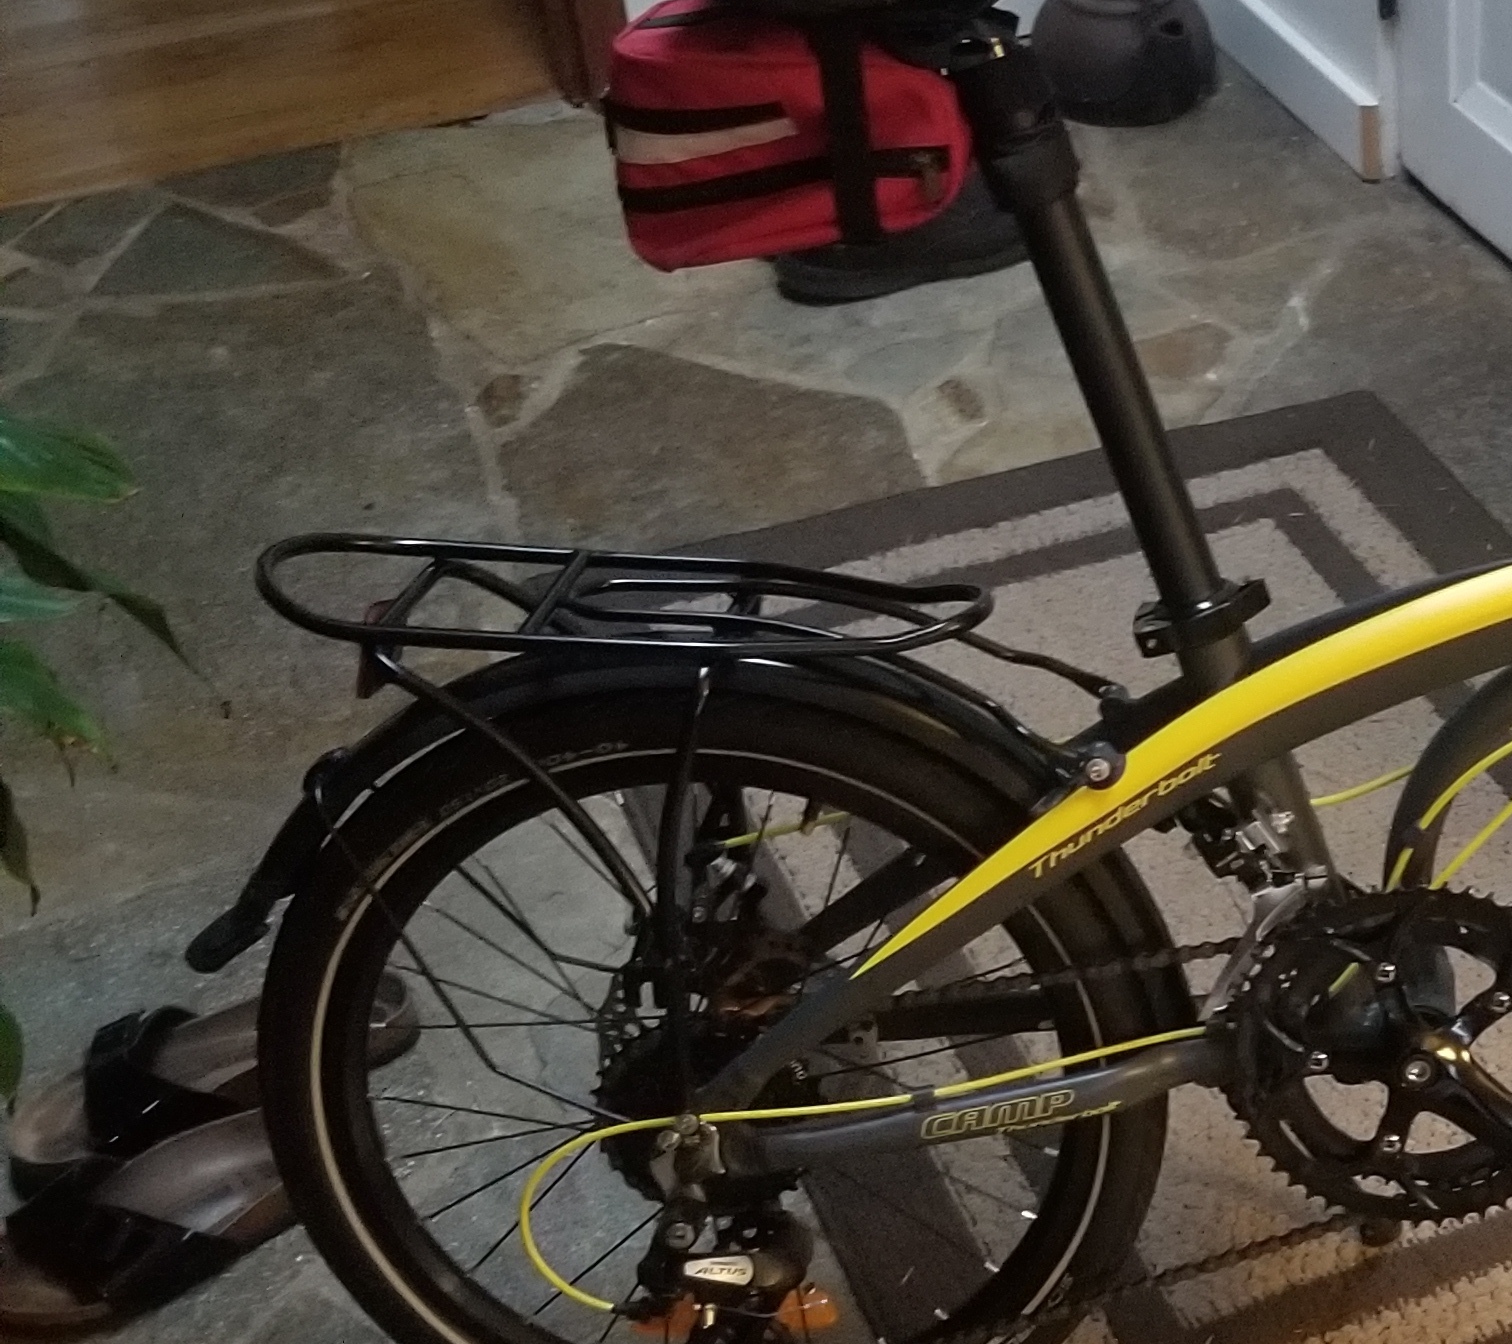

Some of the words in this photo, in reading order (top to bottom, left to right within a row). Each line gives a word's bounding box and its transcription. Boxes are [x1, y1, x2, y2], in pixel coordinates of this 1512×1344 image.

[1028, 750, 1223, 879] Thunderbolt
[921, 1089, 1076, 1140] CAMP
[694, 1267, 748, 1276] ALTUS
